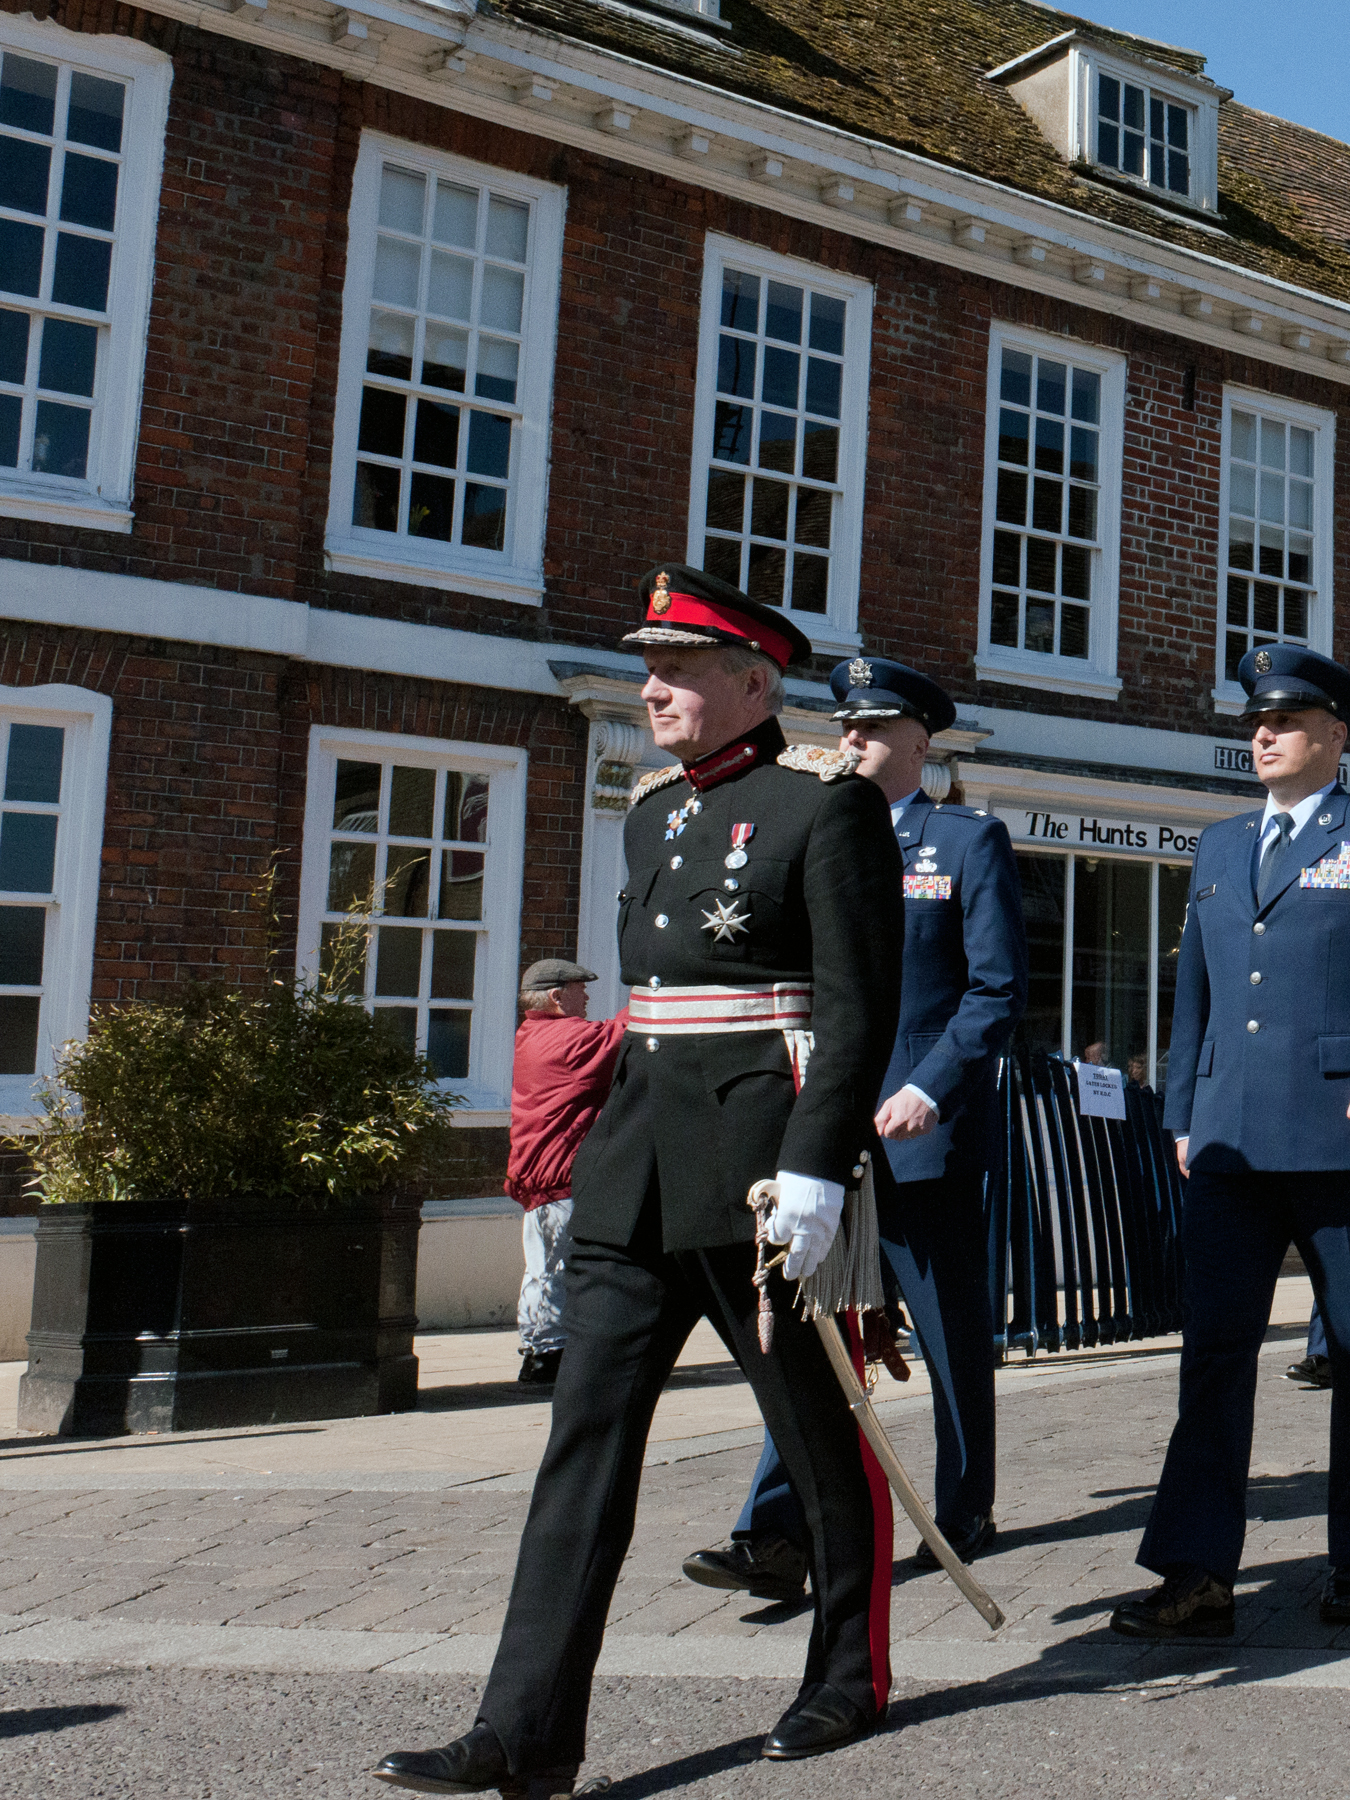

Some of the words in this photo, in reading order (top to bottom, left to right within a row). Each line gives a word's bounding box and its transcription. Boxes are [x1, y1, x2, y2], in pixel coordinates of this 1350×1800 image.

[1215, 747, 1255, 773] HIG
[1025, 811, 1069, 839] The
[1079, 818, 1148, 848] Hunts
[1158, 826, 1199, 853] Pos
